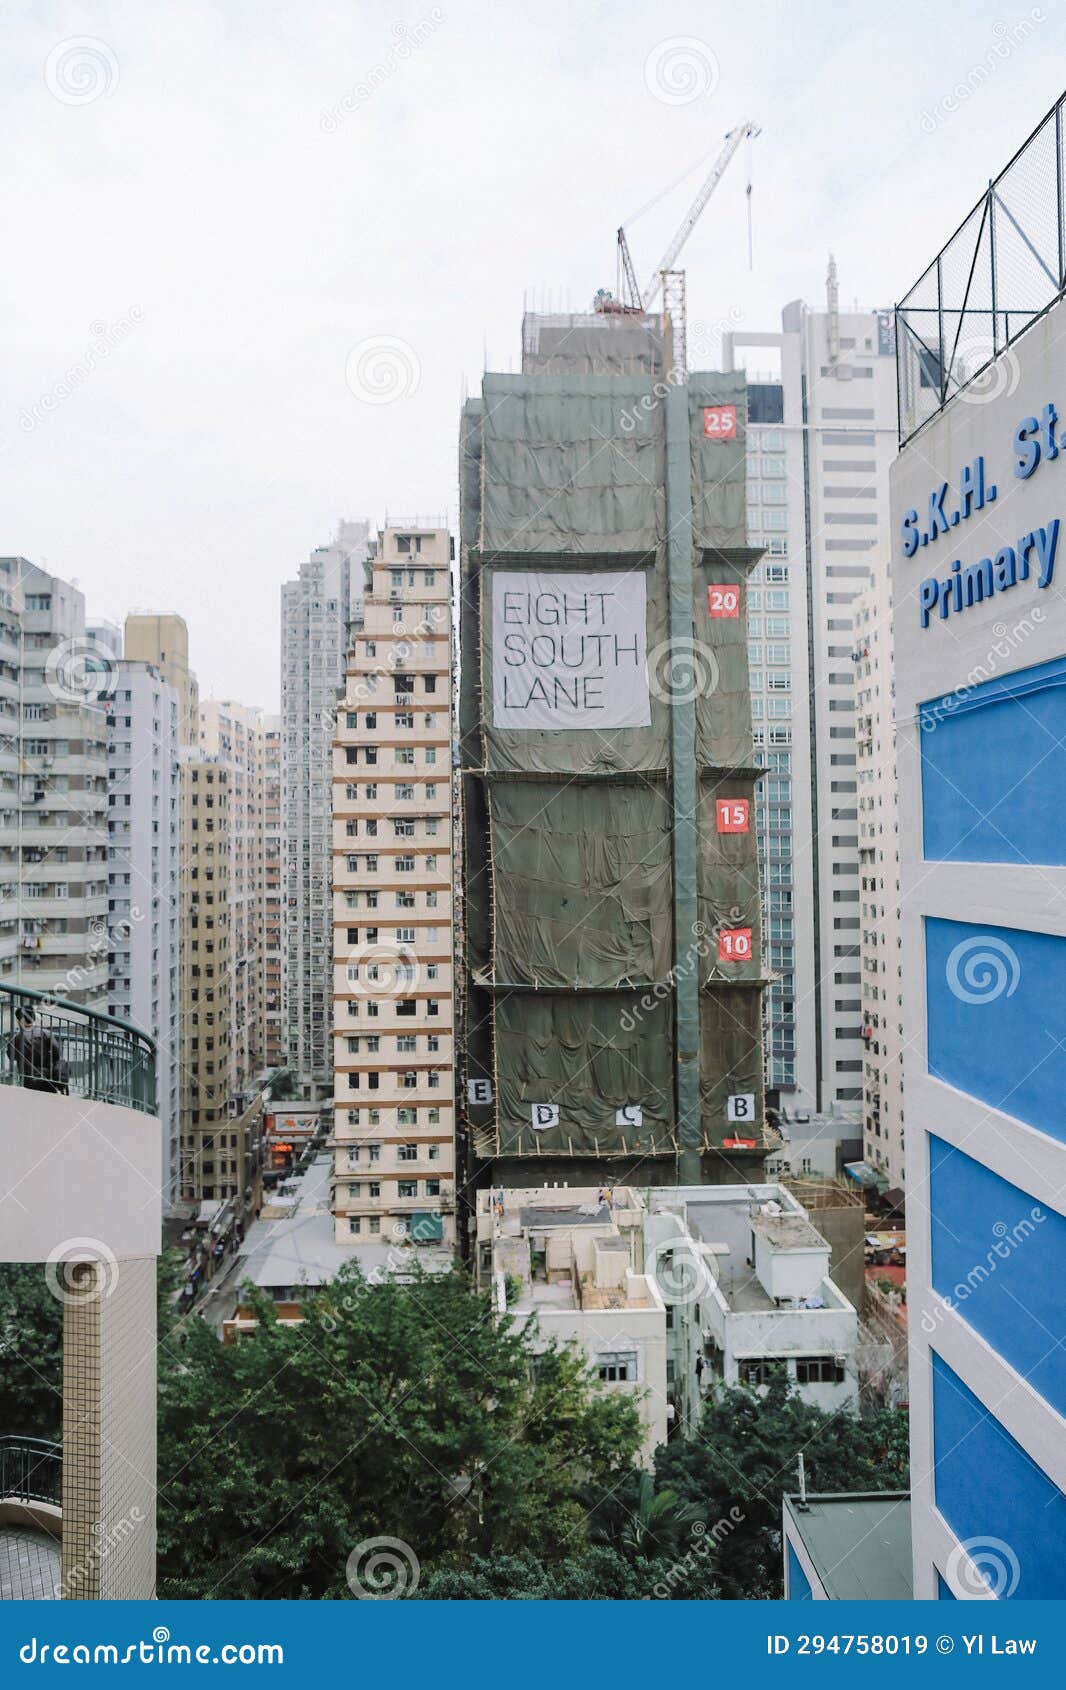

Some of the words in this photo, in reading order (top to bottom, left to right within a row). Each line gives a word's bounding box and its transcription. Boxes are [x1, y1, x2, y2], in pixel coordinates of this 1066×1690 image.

[707, 413, 733, 431] 25
[902, 456, 997, 558] S.K.H.
[919, 519, 1060, 628] Primary
[503, 591, 615, 626] EIGHT
[711, 591, 737, 610] 20
[503, 633, 639, 668] SOUTH
[503, 676, 605, 709] LANE
[720, 806, 745, 825] 15
[723, 935, 749, 955] 10
[474, 1082, 487, 1101] E
[537, 1105, 554, 1124] D
[734, 1097, 748, 1117] B
